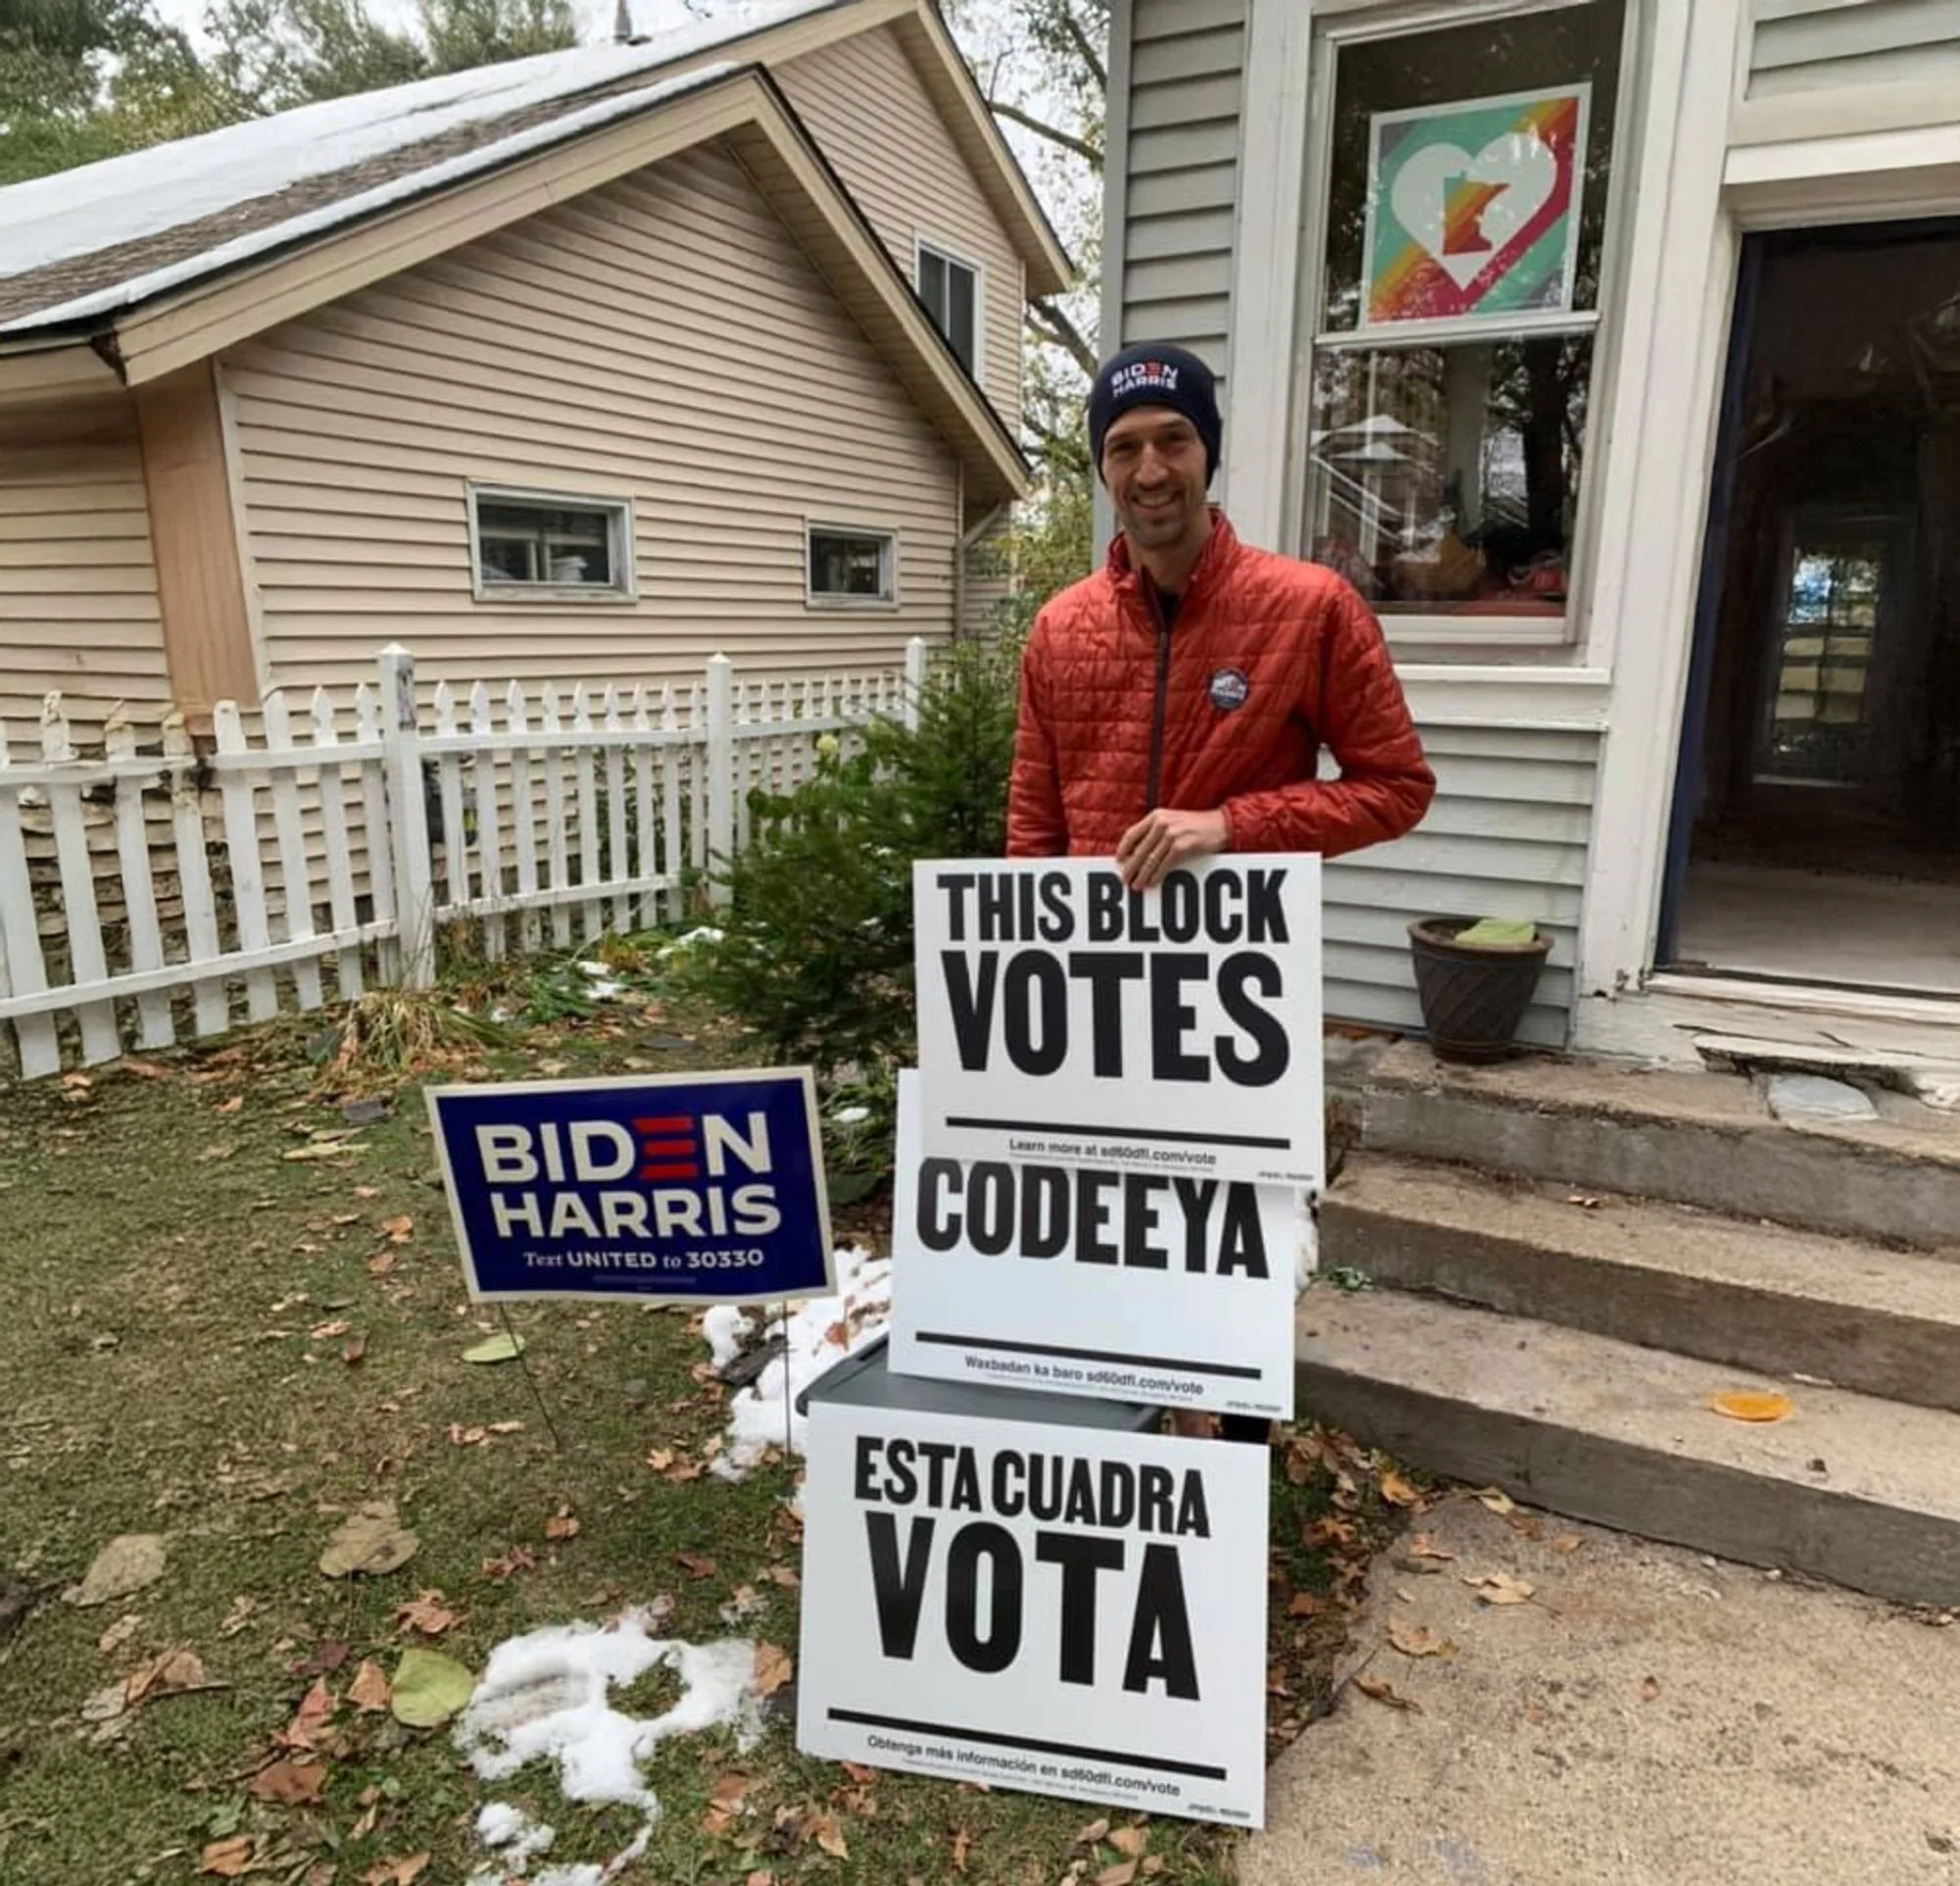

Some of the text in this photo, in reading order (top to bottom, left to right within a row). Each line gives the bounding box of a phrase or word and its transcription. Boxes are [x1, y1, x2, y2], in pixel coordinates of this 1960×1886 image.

[1110, 360, 1178, 386] BIDEN
[1112, 374, 1177, 398] HARRIS
[937, 869, 1290, 944] THIS BLOCK
[941, 949, 1290, 1087] VOTES
[475, 1112, 772, 1183] BIDEN
[1009, 1137, 1045, 1153] Learn
[1049, 1142, 1081, 1155] more
[1085, 1144, 1098, 1157] at
[490, 1184, 781, 1239] HARRIS
[916, 1158, 1270, 1278] CODEEYA
[523, 1249, 764, 1268] Text UNITED to 30330
[964, 1355, 1030, 1373] Waxbadan
[1034, 1362, 1050, 1376] ka
[1053, 1364, 1083, 1380] baro
[855, 1435, 1210, 1538] ESTA CUADRA
[864, 1510, 1200, 1702] VOTA
[867, 1734, 922, 1757] Obtenga
[926, 1745, 954, 1761] más
[956, 1748, 1037, 1774] información
[1041, 1766, 1057, 1778] en
